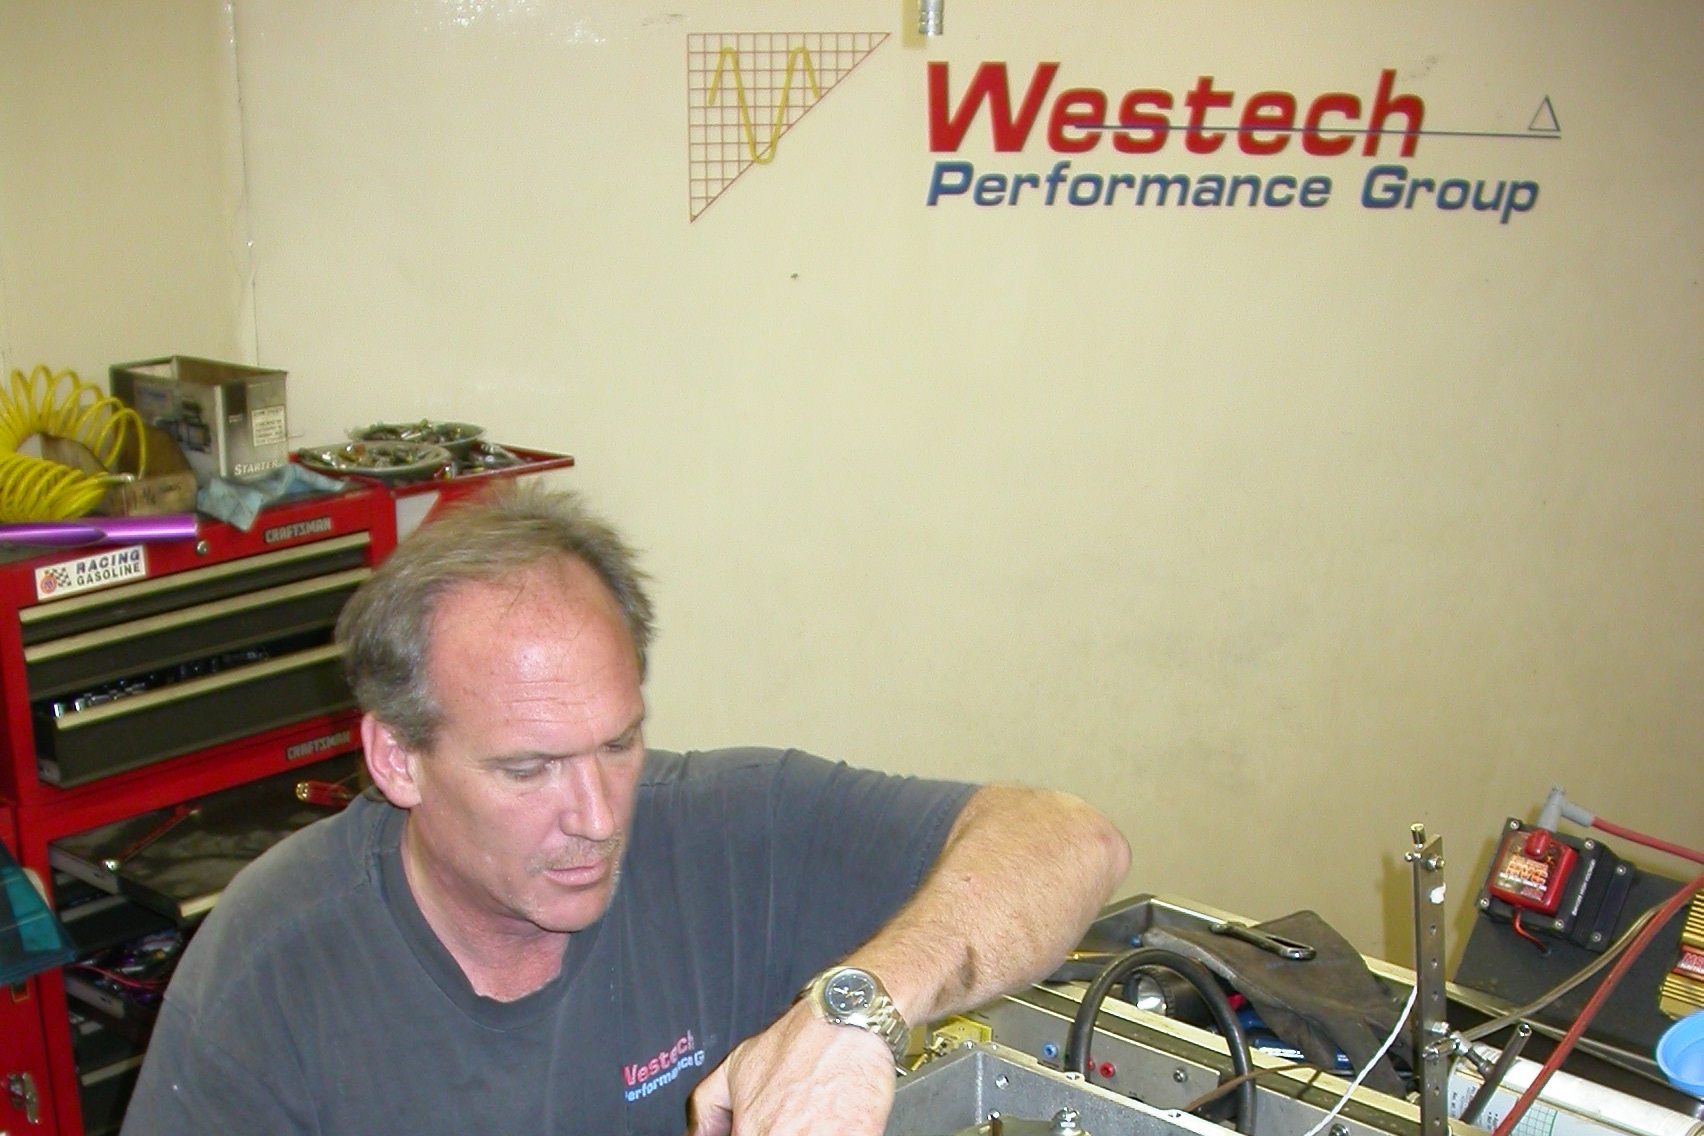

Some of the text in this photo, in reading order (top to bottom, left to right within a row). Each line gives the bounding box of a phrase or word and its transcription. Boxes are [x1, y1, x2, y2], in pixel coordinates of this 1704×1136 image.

[928, 61, 1426, 157] Westech
[926, 160, 1540, 225] Performance Group
[264, 516, 332, 544] CRAFTSMAN
[76, 549, 140, 575] RACING
[76, 562, 140, 587] GASOLINE
